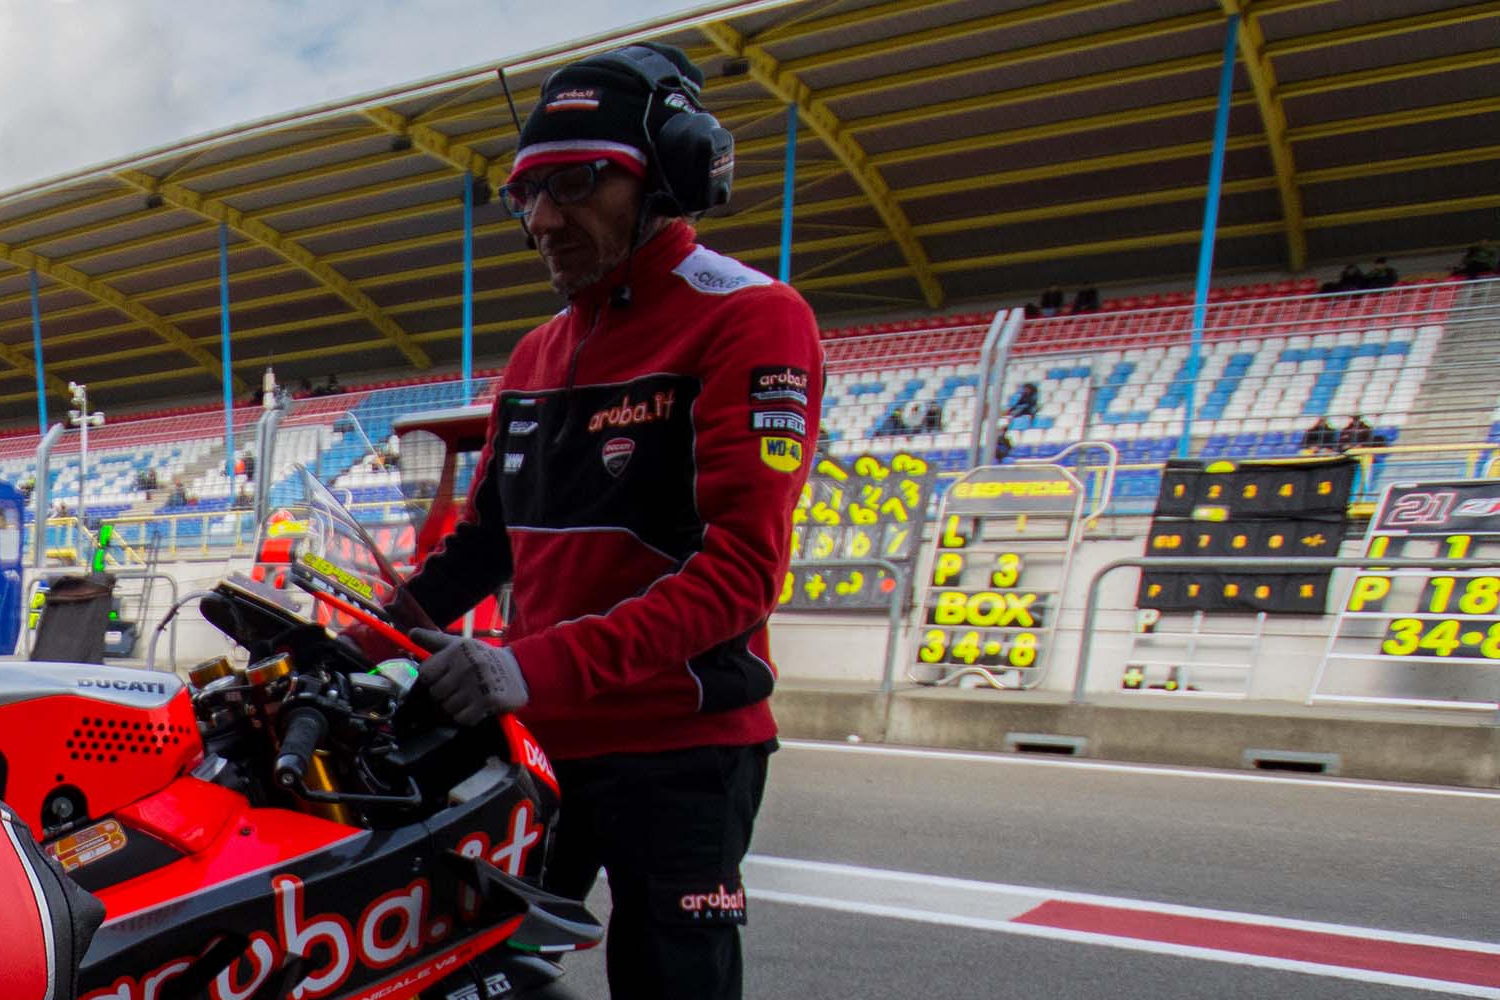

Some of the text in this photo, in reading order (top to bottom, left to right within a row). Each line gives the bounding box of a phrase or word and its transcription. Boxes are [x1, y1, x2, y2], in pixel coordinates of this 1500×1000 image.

[588, 390, 675, 432] aruba.it
[1384, 493, 1457, 525] 21
[935, 553, 1020, 588] P 3
[935, 591, 1037, 627] BOX
[1348, 576, 1500, 615] P 18
[77, 678, 165, 695] DUCATI
